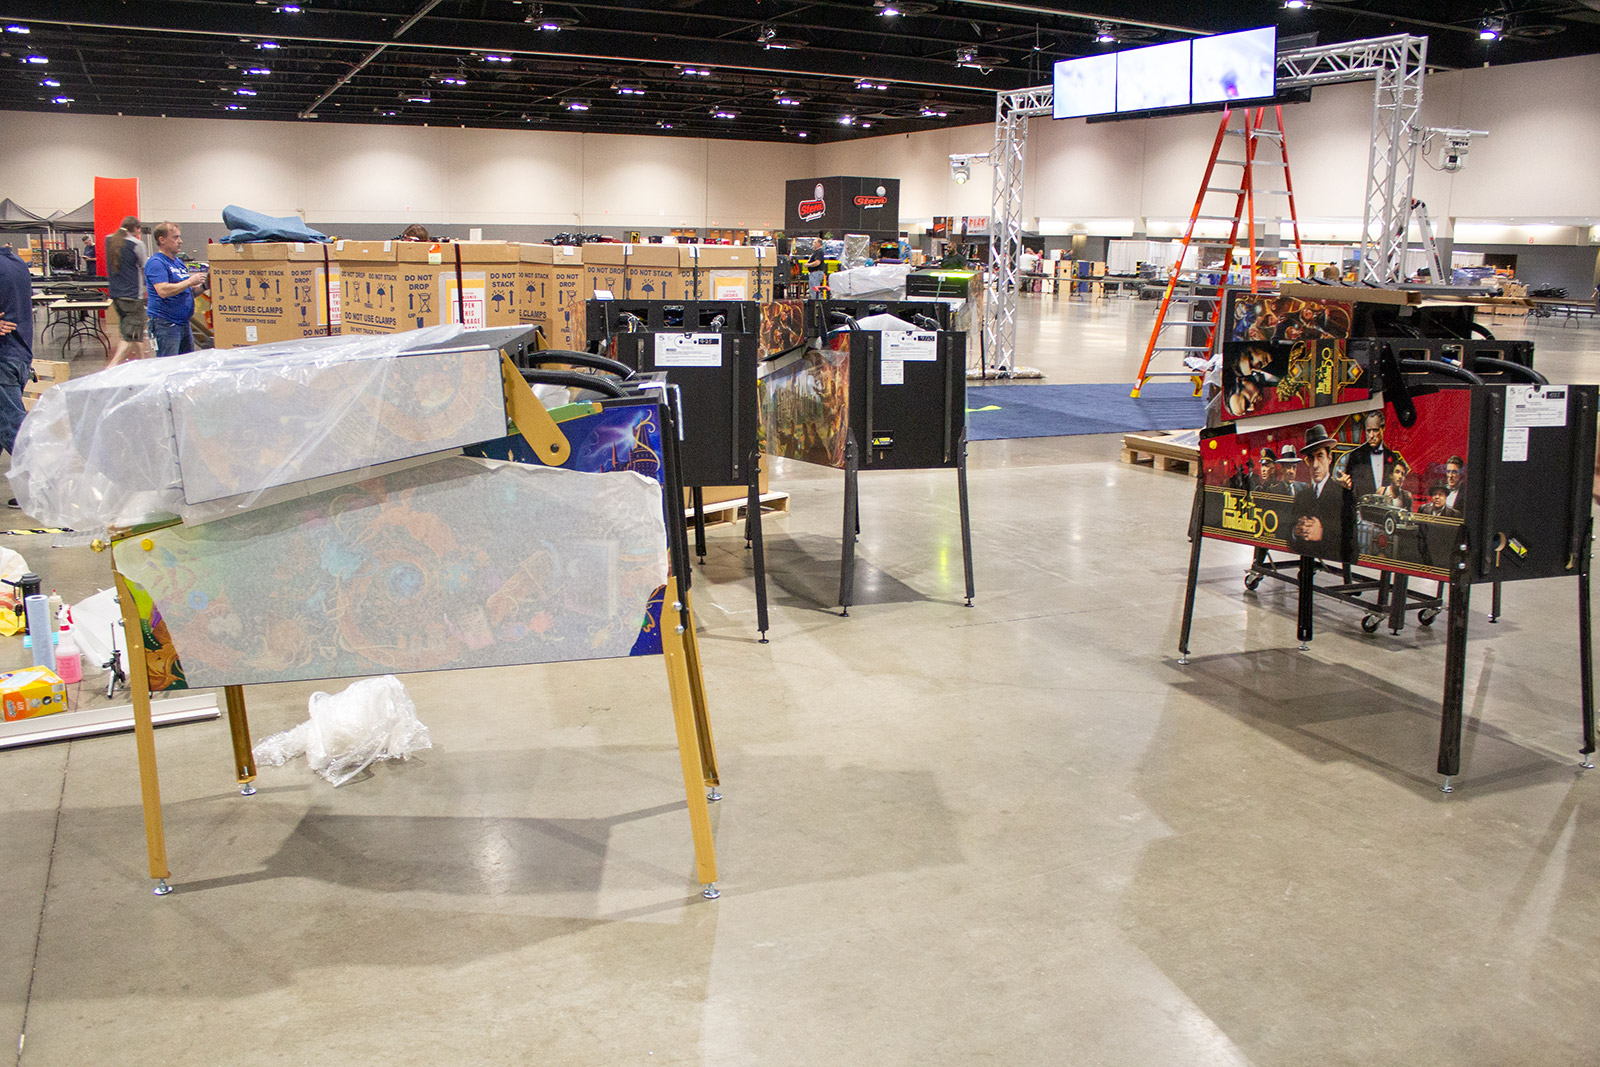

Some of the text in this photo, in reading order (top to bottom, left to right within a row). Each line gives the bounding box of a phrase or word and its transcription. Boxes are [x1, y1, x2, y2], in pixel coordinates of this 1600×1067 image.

[364, 314, 374, 322] USE
[375, 316, 396, 326] CLAMPS
[523, 310, 547, 318] CLAMPS
[1322, 347, 1334, 367] 50
[1223, 491, 1237, 509] The
[1222, 507, 1278, 538] Godfather 50
